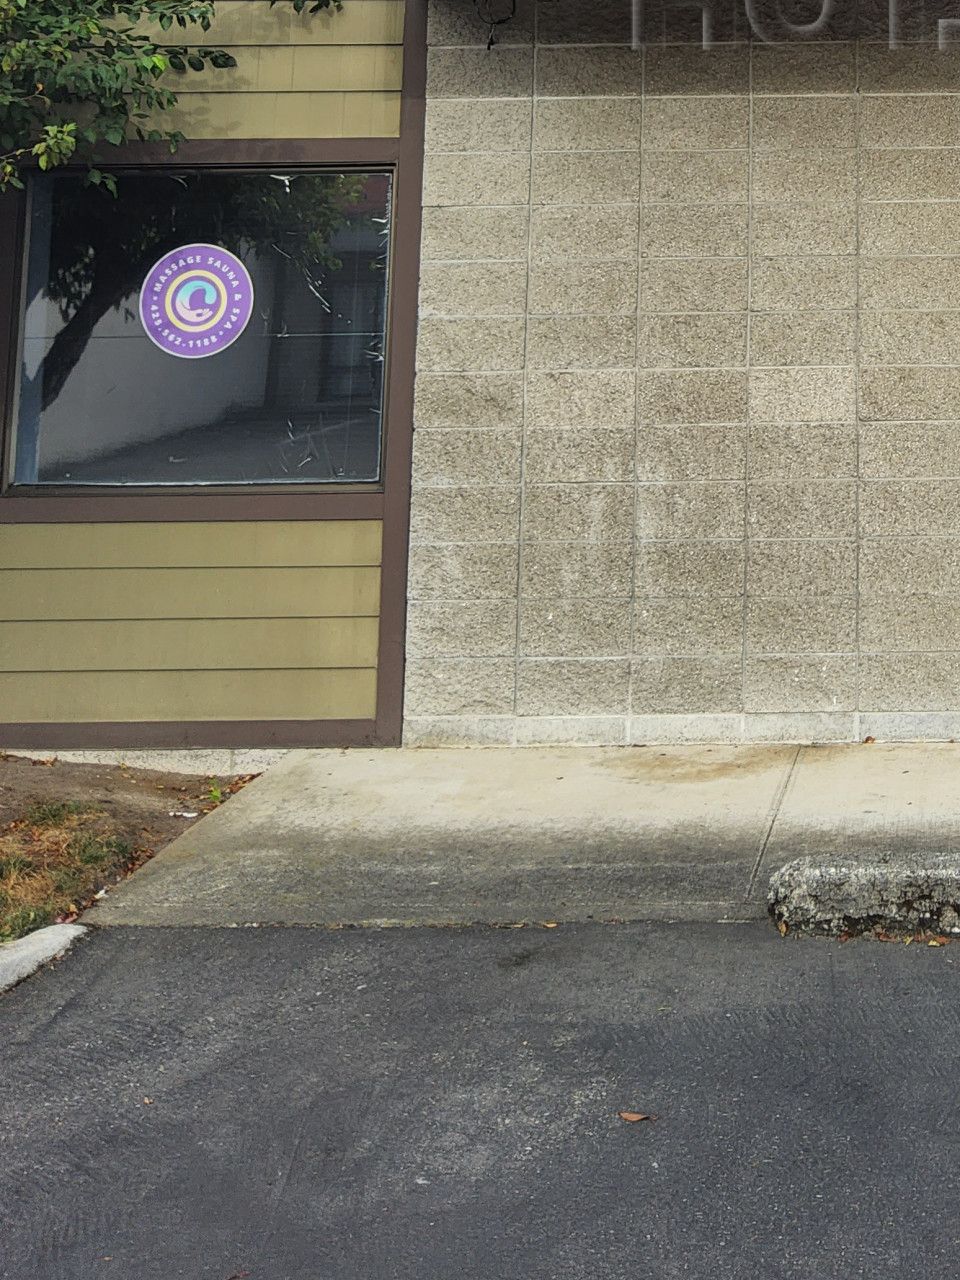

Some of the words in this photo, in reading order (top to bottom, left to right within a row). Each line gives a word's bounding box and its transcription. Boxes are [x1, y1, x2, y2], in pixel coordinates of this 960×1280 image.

[153, 255, 202, 293] MASSAGE
[207, 257, 240, 288] SAUNA
[223, 307, 241, 330] SPA
